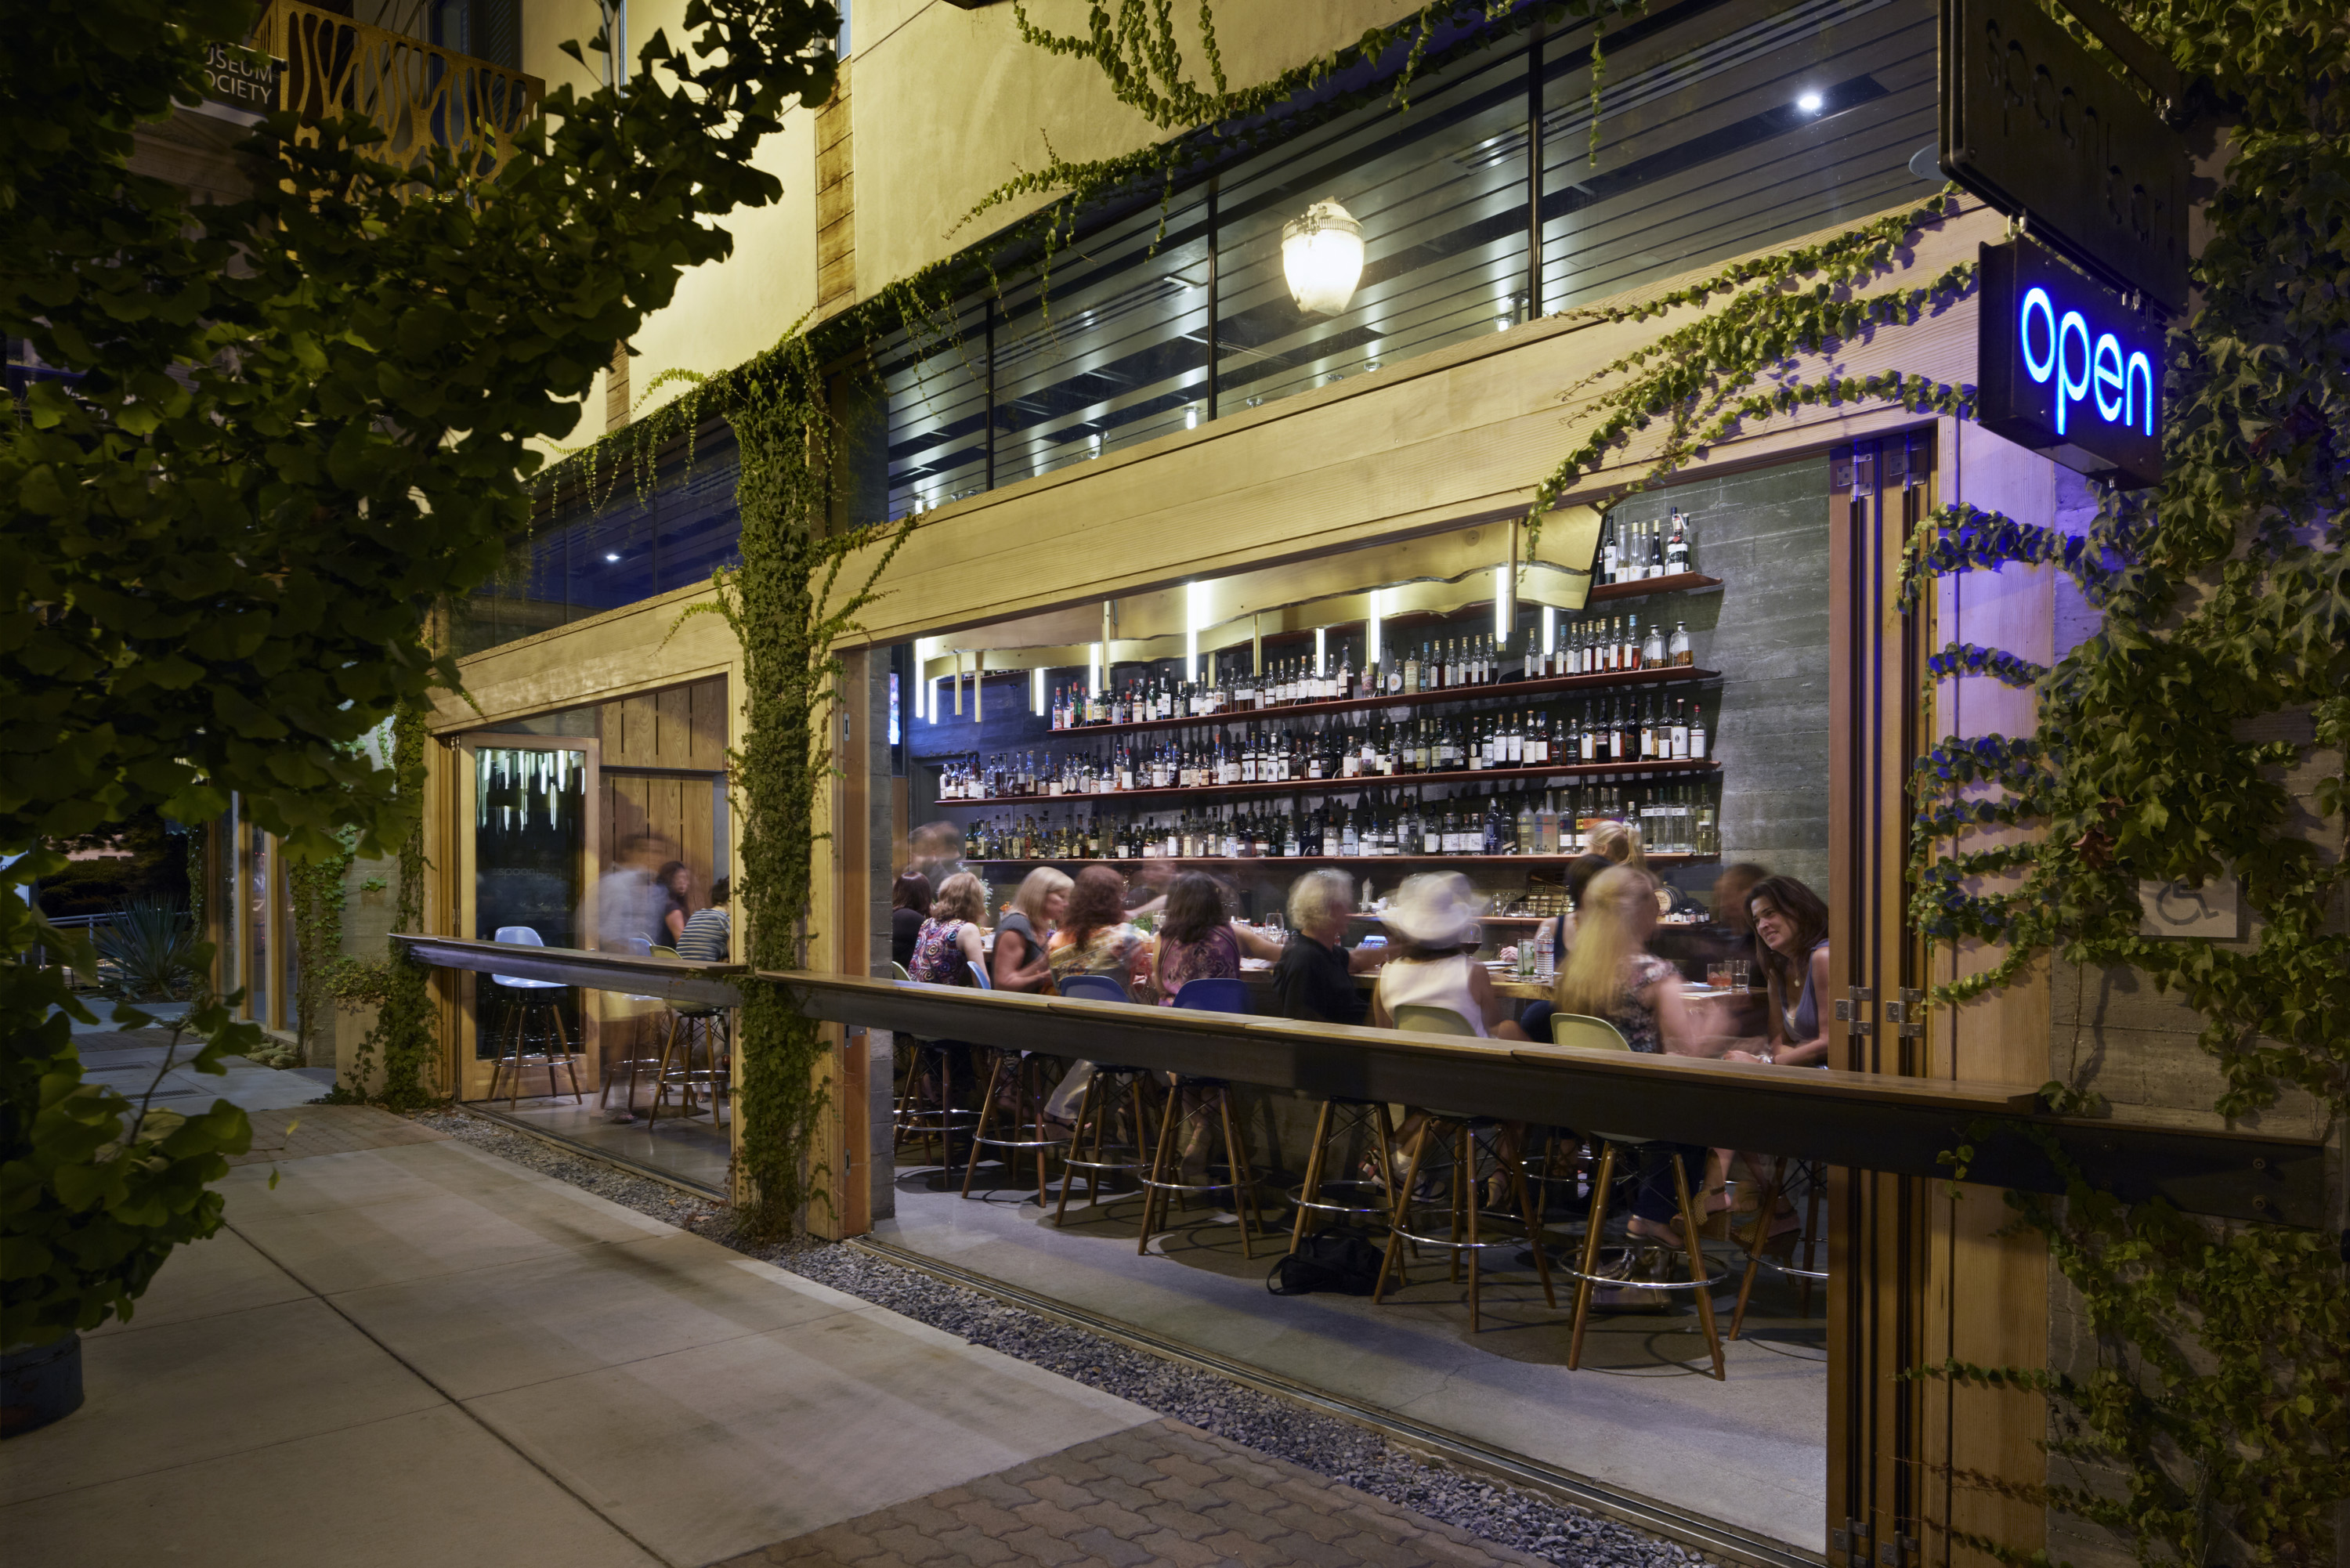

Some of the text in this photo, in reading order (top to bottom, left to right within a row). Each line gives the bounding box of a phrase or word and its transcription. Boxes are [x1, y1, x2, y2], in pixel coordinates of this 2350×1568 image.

[206, 47, 272, 83] USEUM
[204, 70, 272, 104] OCIETY
[2021, 287, 2153, 436] open
